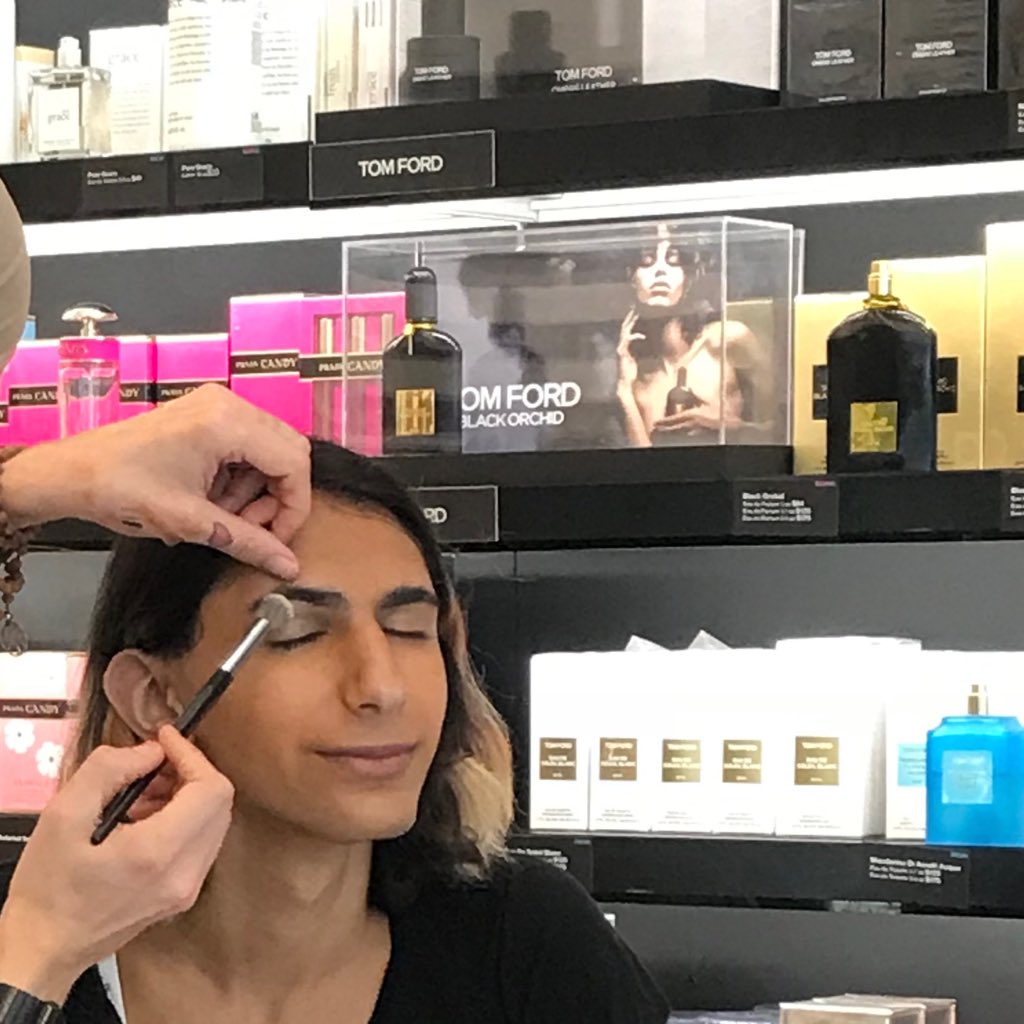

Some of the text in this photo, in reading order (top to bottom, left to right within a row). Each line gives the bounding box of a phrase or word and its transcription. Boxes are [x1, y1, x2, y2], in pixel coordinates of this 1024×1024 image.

[554, 65, 613, 81] TOM FORD
[357, 155, 445, 178] TOM FORD
[260, 357, 298, 370] CANDY
[461, 381, 582, 412] OM FORD
[507, 410, 565, 427] ORCHID
[422, 506, 448, 524] RD
[25, 703, 60, 715] CANDY
